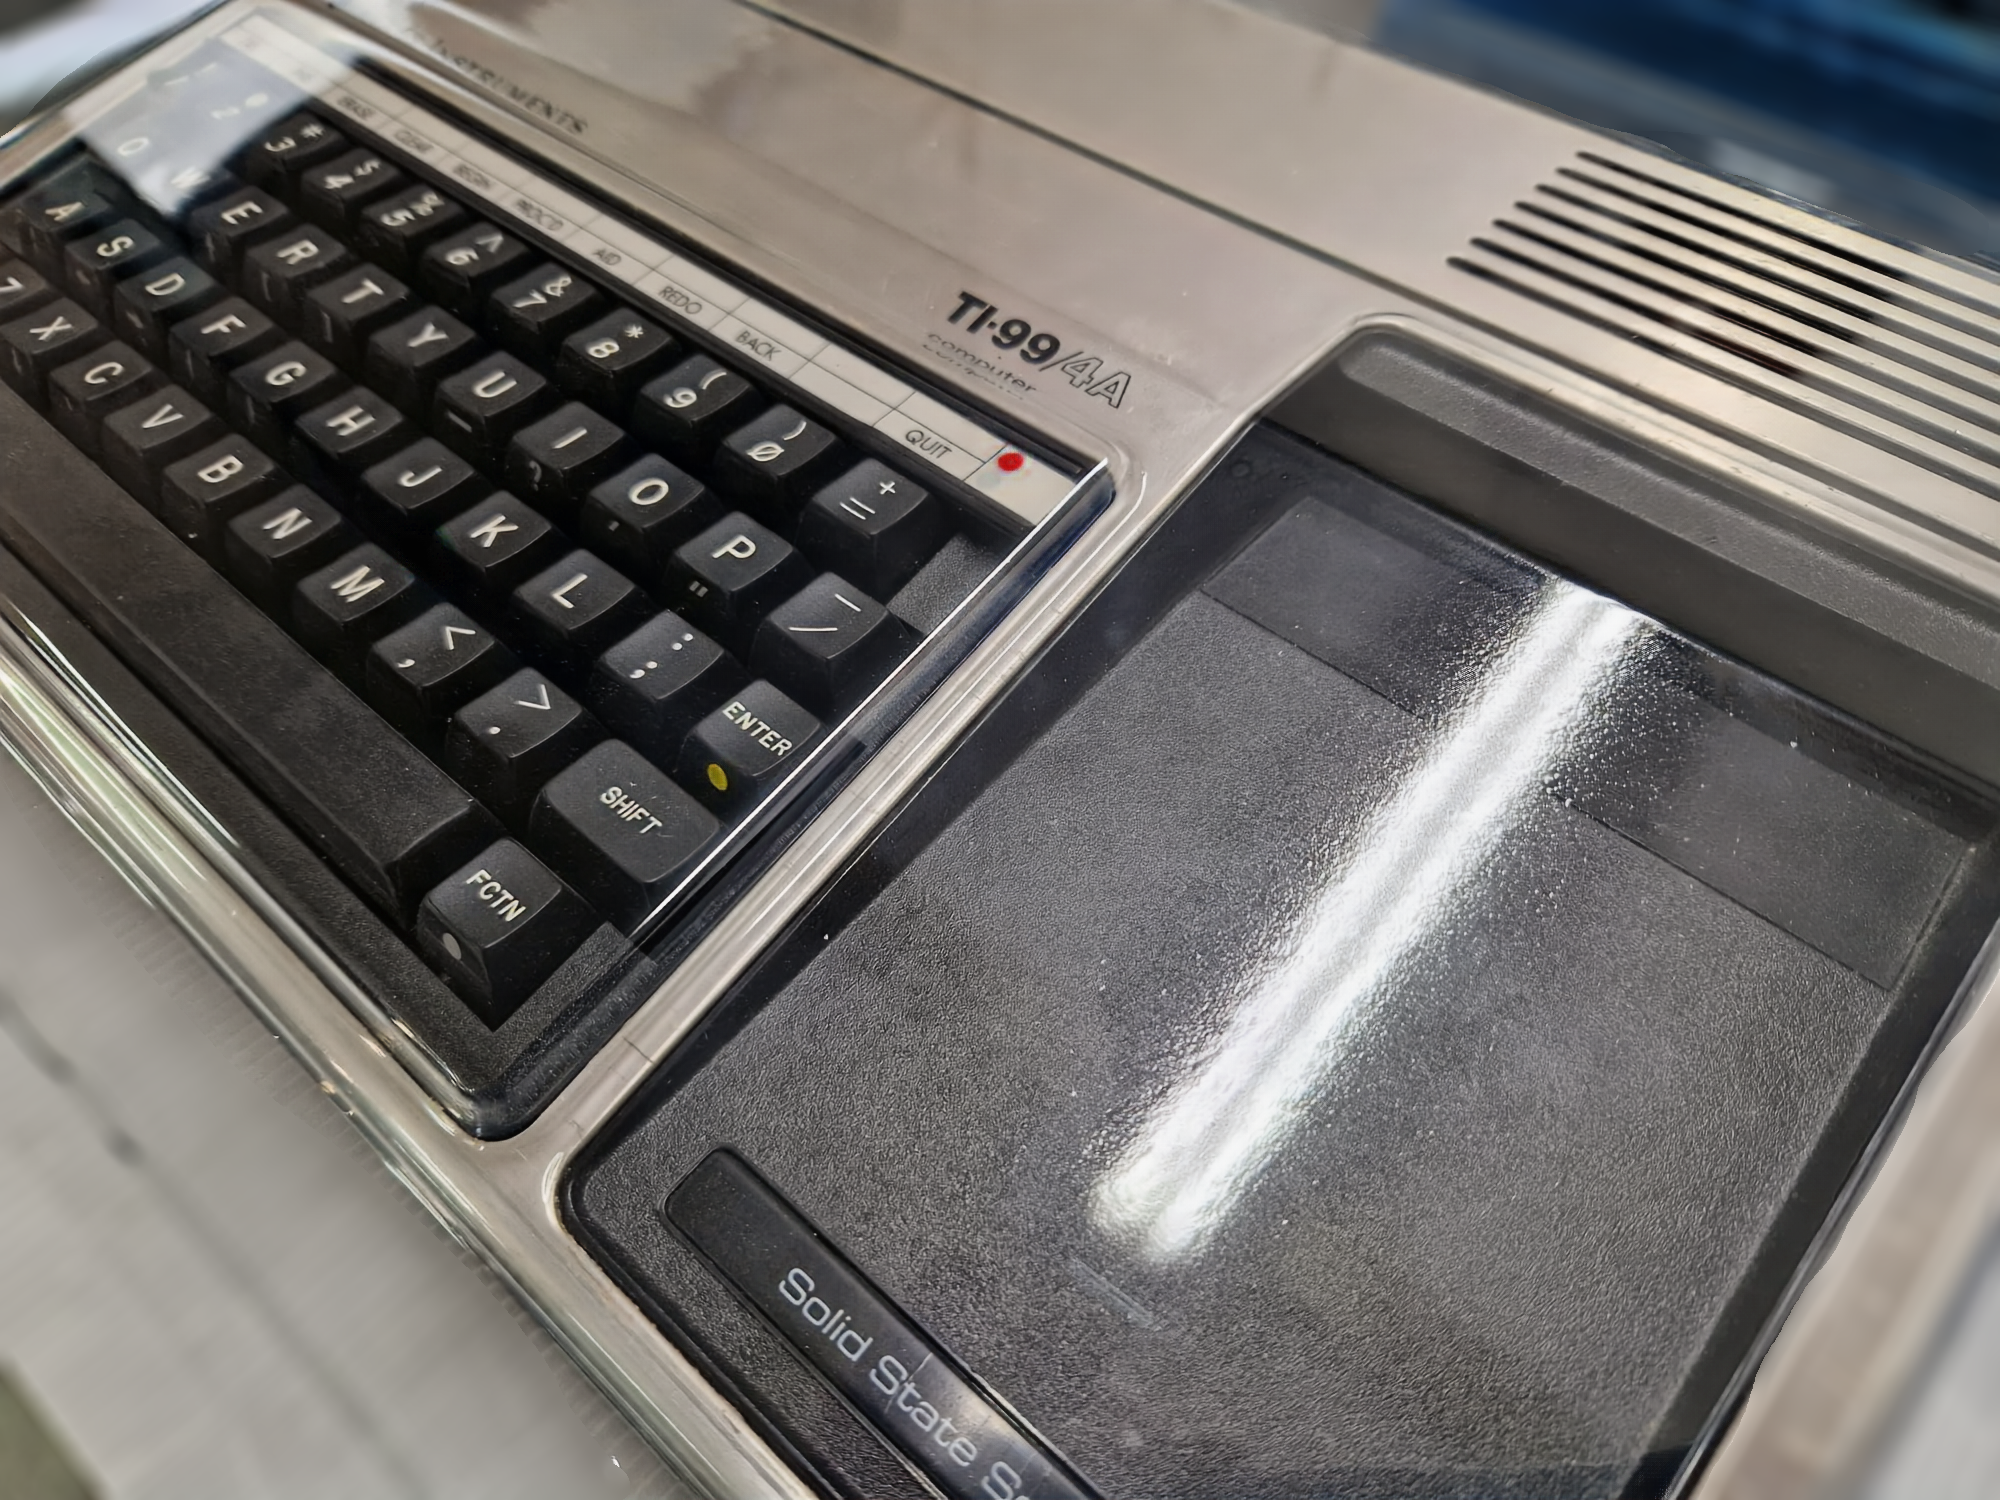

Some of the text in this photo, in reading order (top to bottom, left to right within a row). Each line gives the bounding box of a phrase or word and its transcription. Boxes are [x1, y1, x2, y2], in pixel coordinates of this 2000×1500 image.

[265, 137, 295, 151] 3
[326, 176, 353, 188] 4
[46, 202, 83, 220] A
[222, 202, 262, 224] E
[97, 237, 134, 256] S
[278, 241, 318, 264] R
[447, 249, 478, 265] 6
[146, 273, 185, 295] D
[343, 280, 383, 303] T
[545, 276, 571, 296] &
[514, 289, 549, 307] 7
[657, 285, 703, 316] REDO
[30, 317, 72, 340] X
[202, 315, 245, 333] F
[409, 324, 447, 347] Y
[588, 340, 619, 358] 8
[734, 330, 782, 364] BACK
[85, 362, 123, 384] C
[266, 362, 306, 385] G
[926, 332, 1039, 396] computer
[474, 372, 516, 397] U
[702, 370, 726, 389] (
[665, 389, 697, 408] 9
[142, 405, 183, 428] V
[327, 407, 375, 435] H
[783, 421, 806, 440] )
[904, 429, 953, 460] QUIT
[198, 456, 243, 482] B
[399, 467, 442, 487] J
[629, 478, 668, 505] O
[840, 497, 875, 519] =
[263, 508, 311, 539] N
[470, 515, 518, 547] K
[712, 535, 756, 558] P
[331, 566, 384, 602] M
[552, 574, 587, 608] L
[721, 699, 795, 758] ENTER
[600, 785, 664, 835] SHIFT
[464, 867, 528, 924] FCTN
[778, 1267, 1032, 1500] Solid State S
